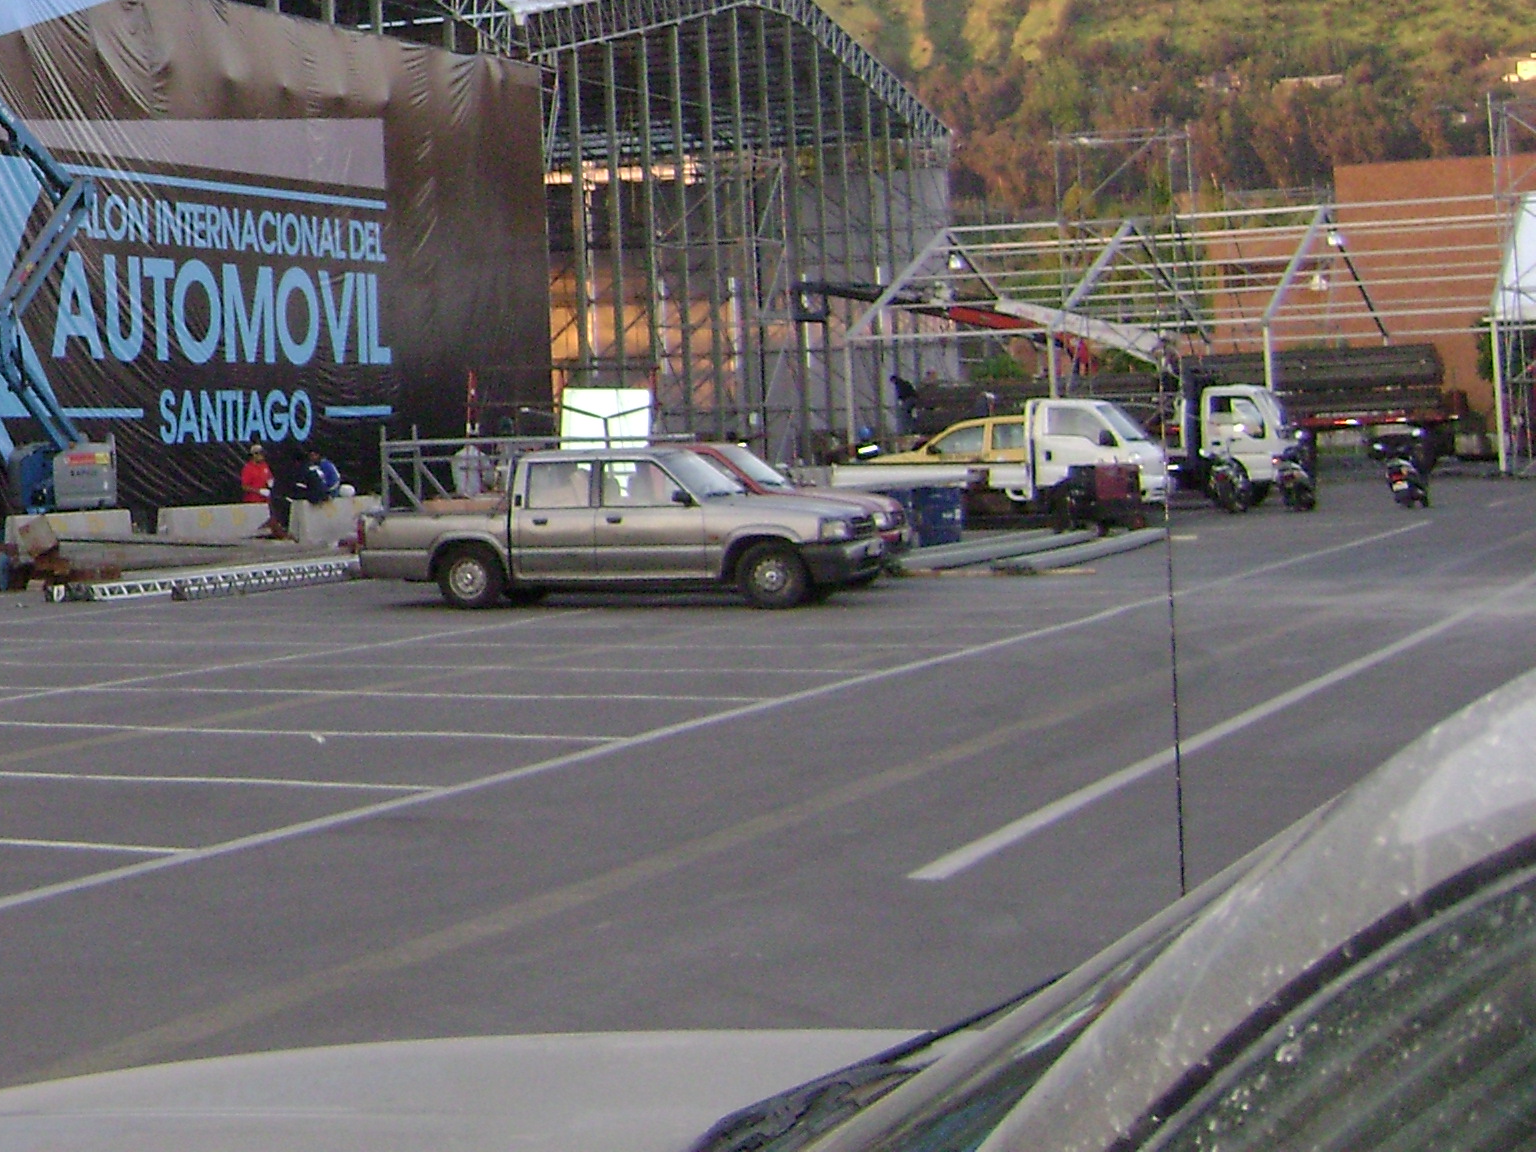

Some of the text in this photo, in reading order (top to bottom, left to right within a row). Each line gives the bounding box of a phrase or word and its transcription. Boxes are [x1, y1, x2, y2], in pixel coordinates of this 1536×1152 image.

[60, 192, 387, 262] ALON INTERNACIONAL DEL
[52, 251, 393, 366] AUTOMOVIL
[159, 389, 312, 445] SANTIAGO
